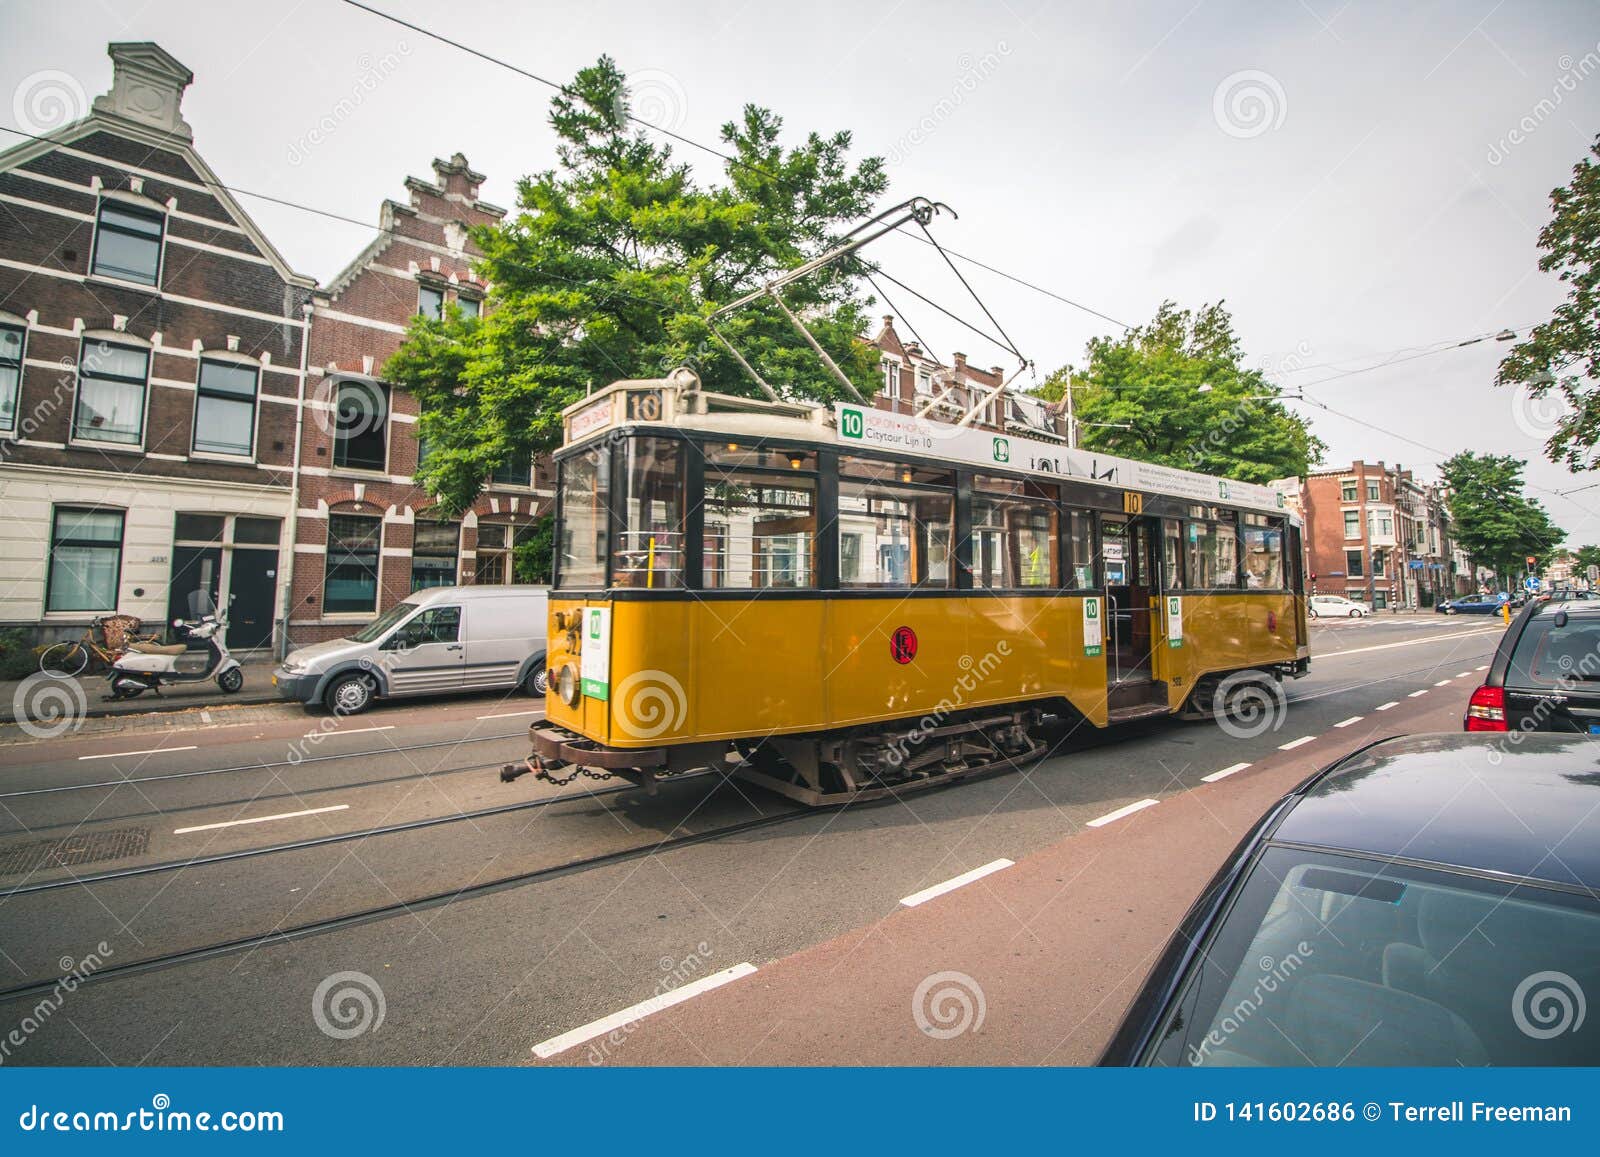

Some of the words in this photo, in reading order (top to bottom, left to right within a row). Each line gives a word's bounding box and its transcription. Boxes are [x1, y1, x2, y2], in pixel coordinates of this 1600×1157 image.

[631, 395, 659, 421] 10
[843, 413, 861, 434] 10
[866, 428, 901, 443] Citytour
[922, 438, 932, 448] 10
[1128, 494, 1139, 512] 10
[1086, 601, 1097, 616] 10
[1169, 600, 1178, 613] 10
